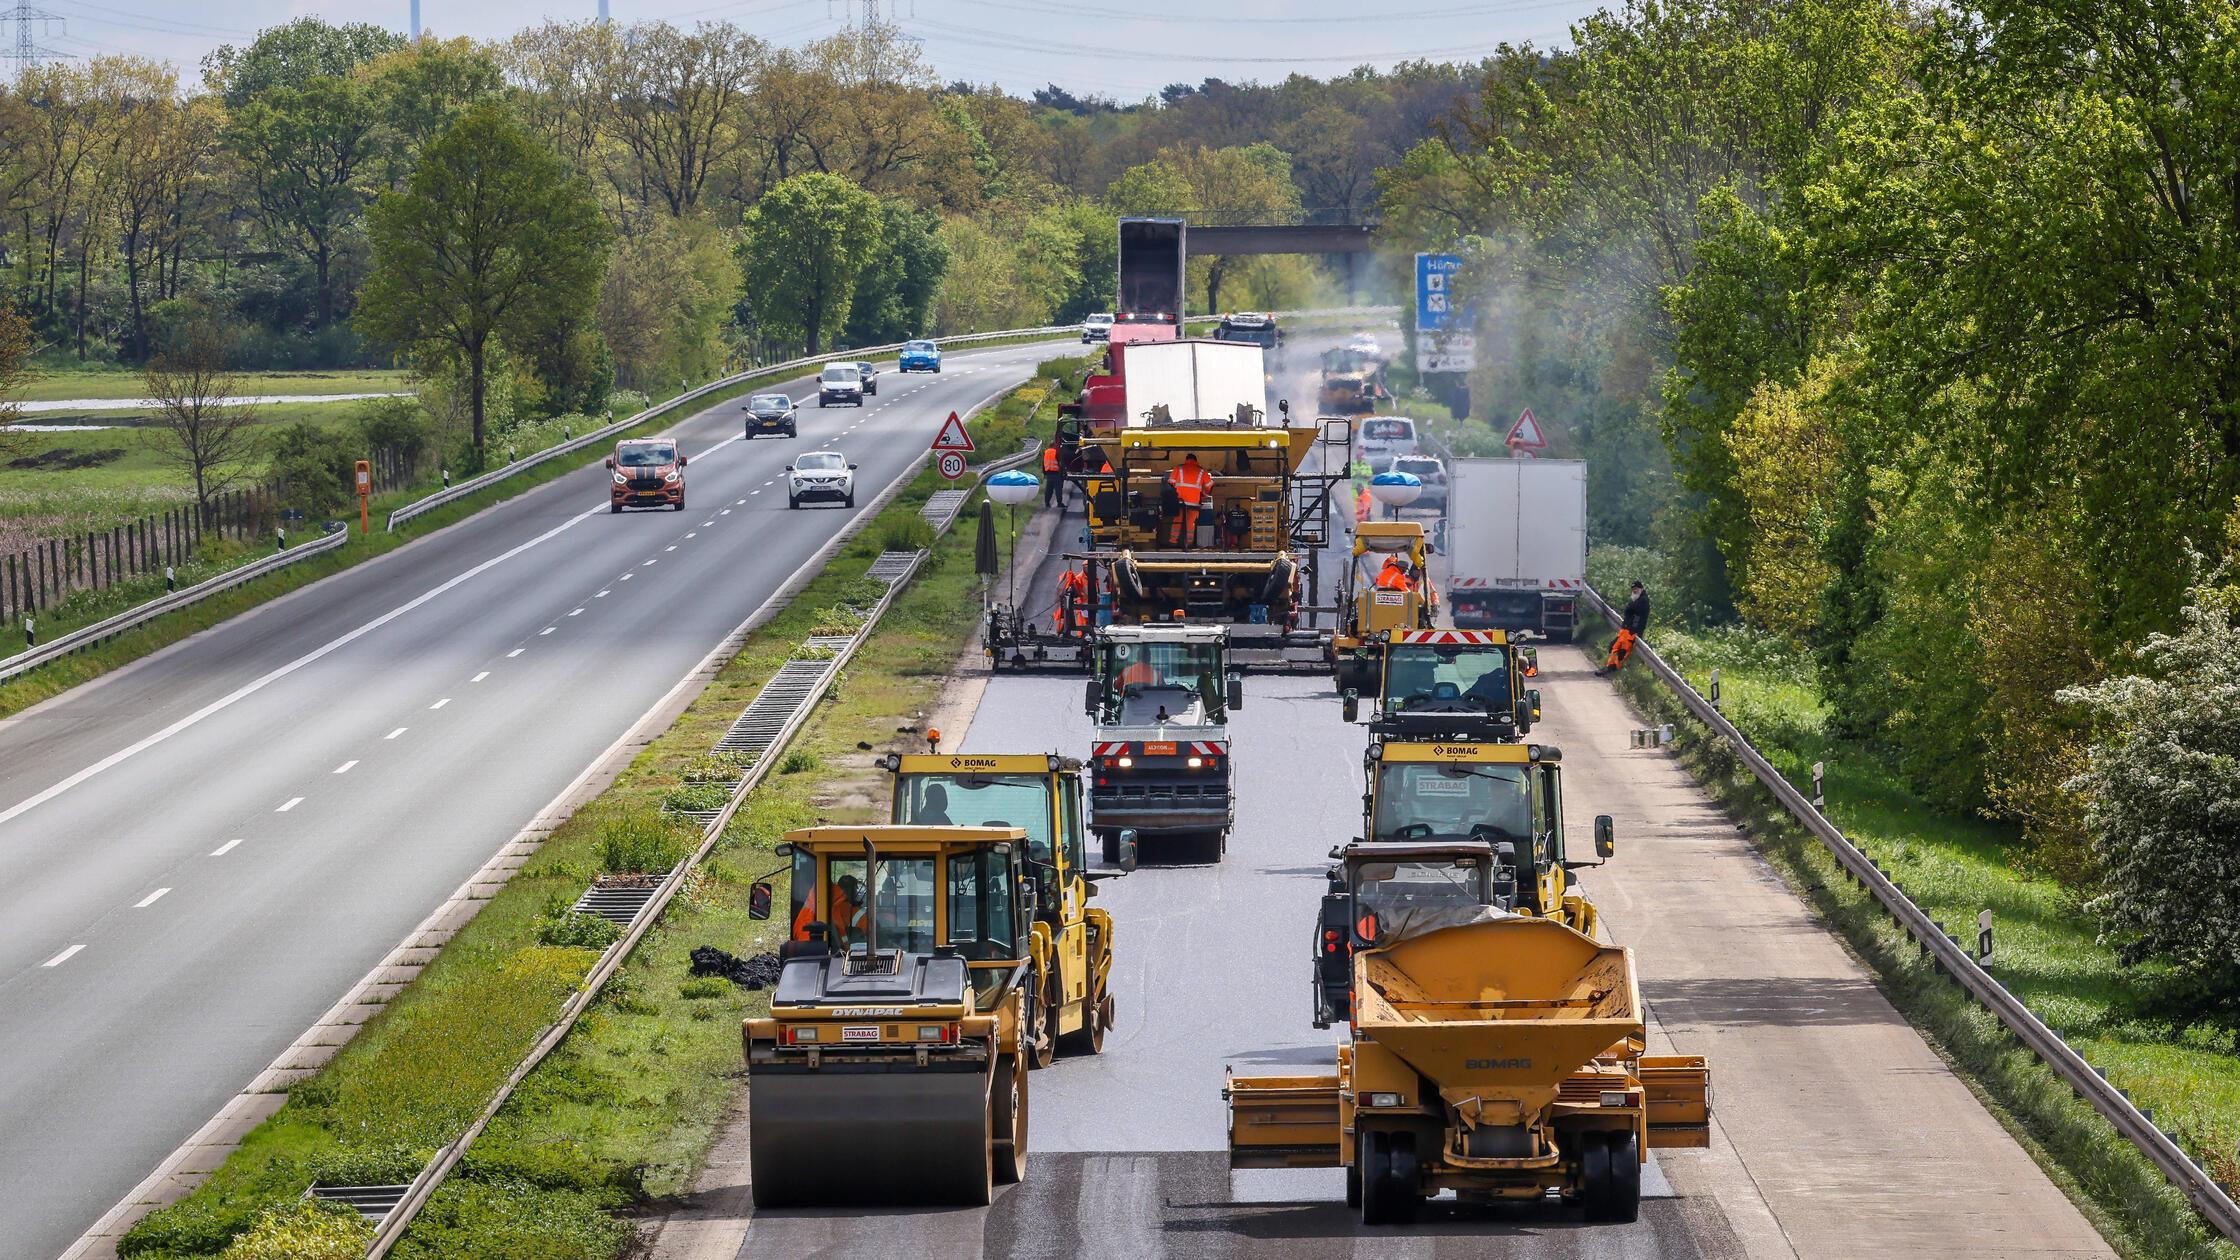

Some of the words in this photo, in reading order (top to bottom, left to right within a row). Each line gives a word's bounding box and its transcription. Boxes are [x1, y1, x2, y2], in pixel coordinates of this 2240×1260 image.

[944, 459, 960, 472] 80
[1120, 645, 1126, 656] 8
[1446, 747, 1478, 755] BOMAG
[964, 759, 996, 767] BOMAG
[1420, 781, 1466, 790] STRABAG
[831, 1008, 904, 1017] DYNAPAC
[844, 1030, 878, 1038] STRABAG
[1465, 1058, 1532, 1069] BOMAG
